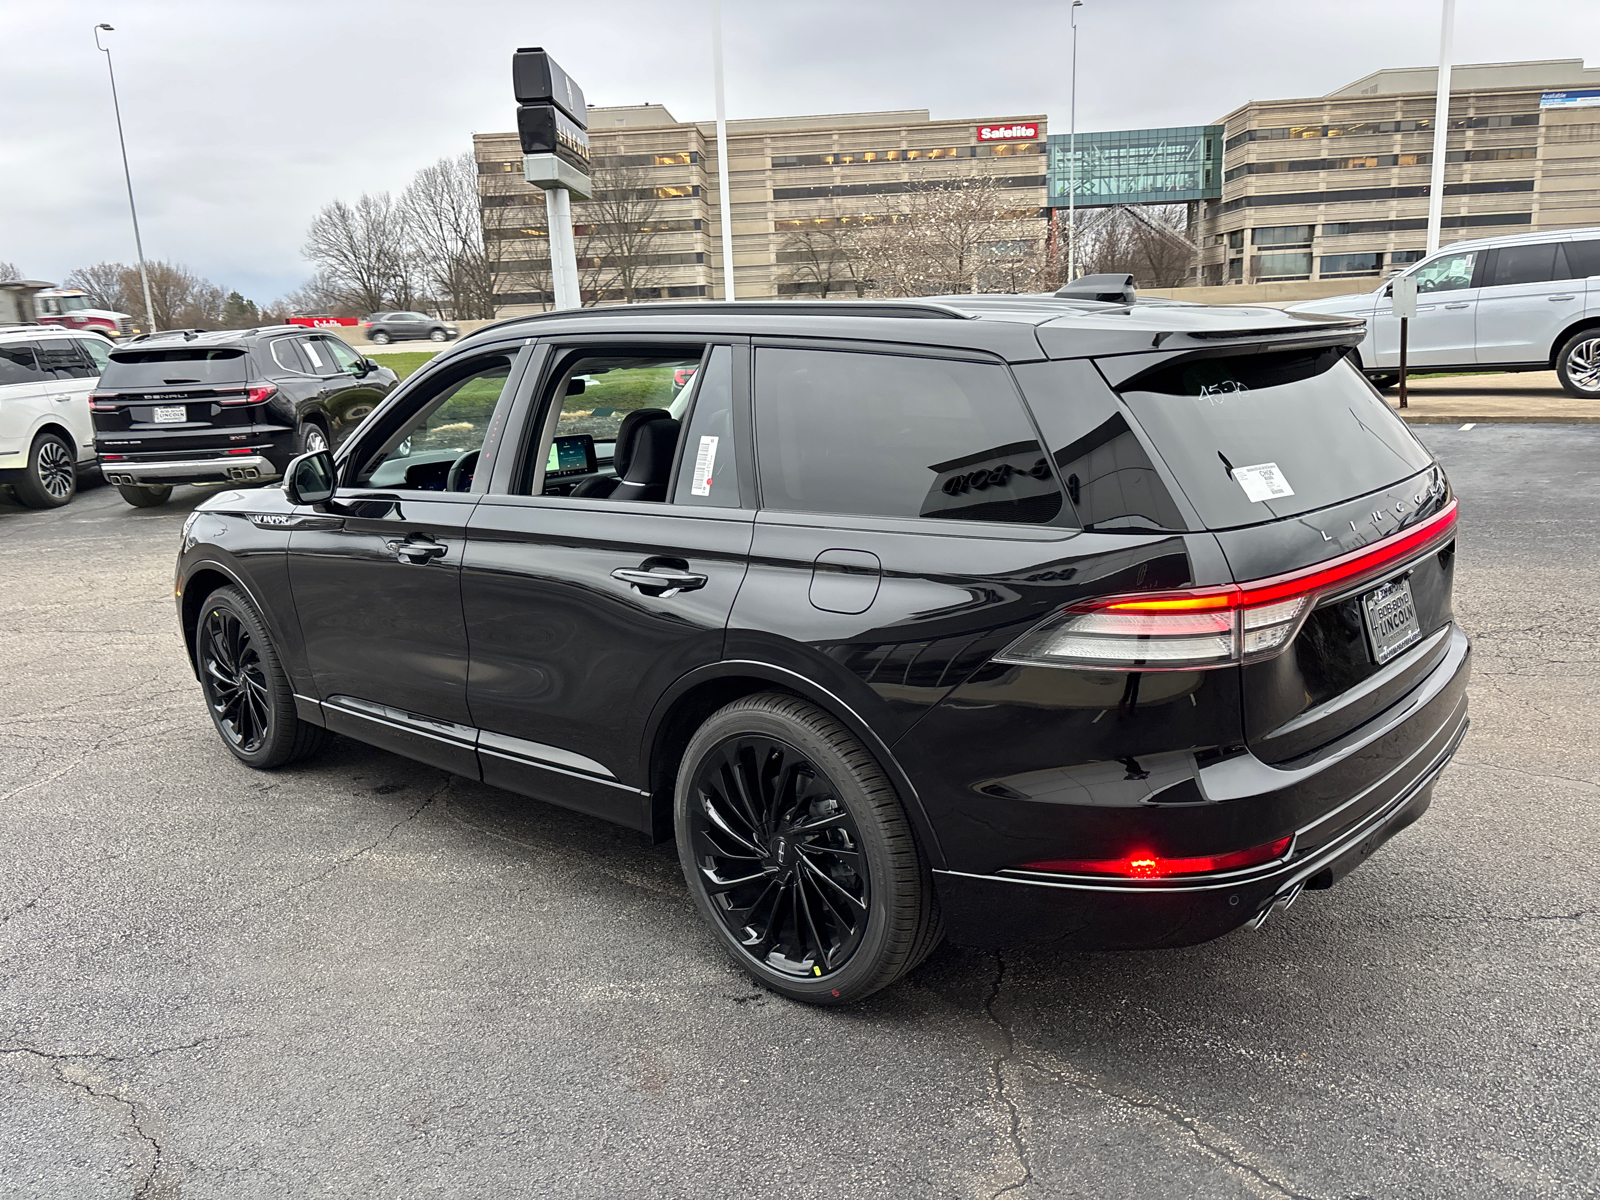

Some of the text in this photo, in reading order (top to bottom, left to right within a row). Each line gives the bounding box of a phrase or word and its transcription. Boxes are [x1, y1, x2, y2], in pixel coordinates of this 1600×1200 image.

[557, 121, 590, 161] LINCOLN
[981, 126, 1035, 138] Safelite
[1320, 481, 1445, 541] LINCOLN
[1378, 592, 1409, 619] BOB-BOYD
[1380, 604, 1414, 636] LINCOLN
